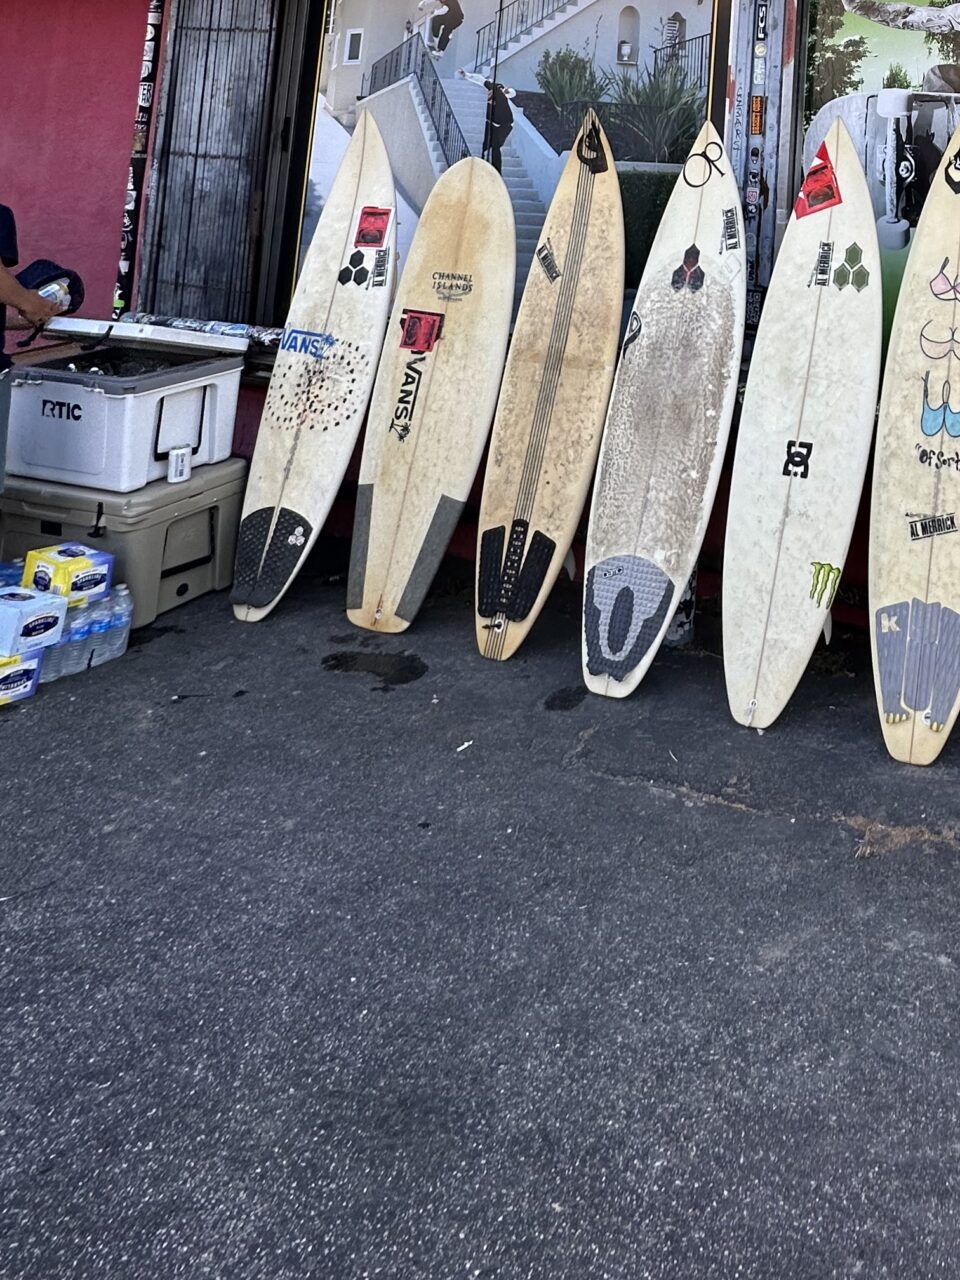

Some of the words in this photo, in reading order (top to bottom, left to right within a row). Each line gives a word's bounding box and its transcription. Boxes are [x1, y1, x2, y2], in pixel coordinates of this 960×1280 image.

[757, 6, 766, 39] FCS
[726, 208, 736, 238] MERRICK
[727, 239, 738, 250] AL
[818, 241, 833, 274] MERRICK
[432, 271, 473, 282] CHANNEL
[432, 281, 474, 292] ISLANDS
[815, 274, 828, 286] AL
[280, 328, 323, 356] VANS
[394, 355, 426, 421] VANS
[42, 400, 82, 422] RTIC
[910, 522, 920, 538] AL
[921, 515, 957, 536] MERRICK
